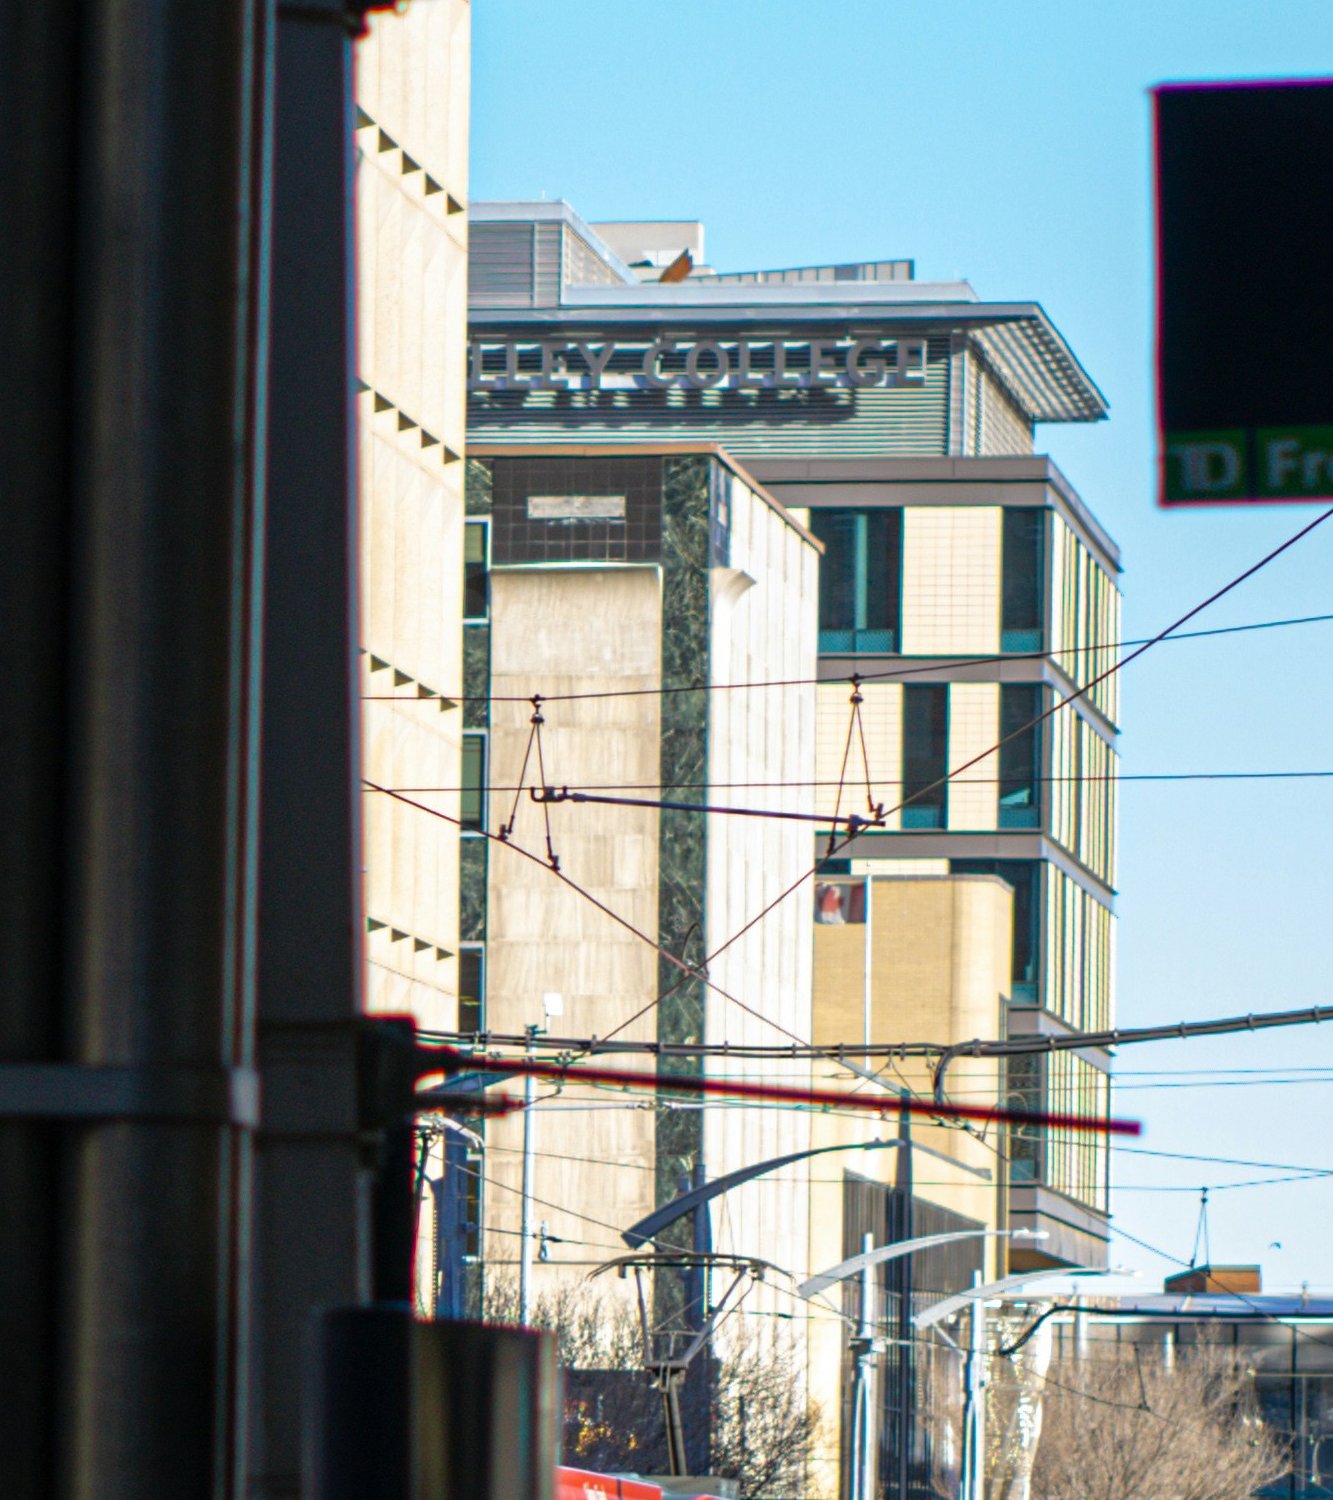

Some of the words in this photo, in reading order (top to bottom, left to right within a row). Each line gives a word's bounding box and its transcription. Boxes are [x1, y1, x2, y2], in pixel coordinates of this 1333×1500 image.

[643, 339, 926, 388] COLLEGE
[1170, 442, 1238, 489] TD
[1267, 438, 1333, 487] Fr
